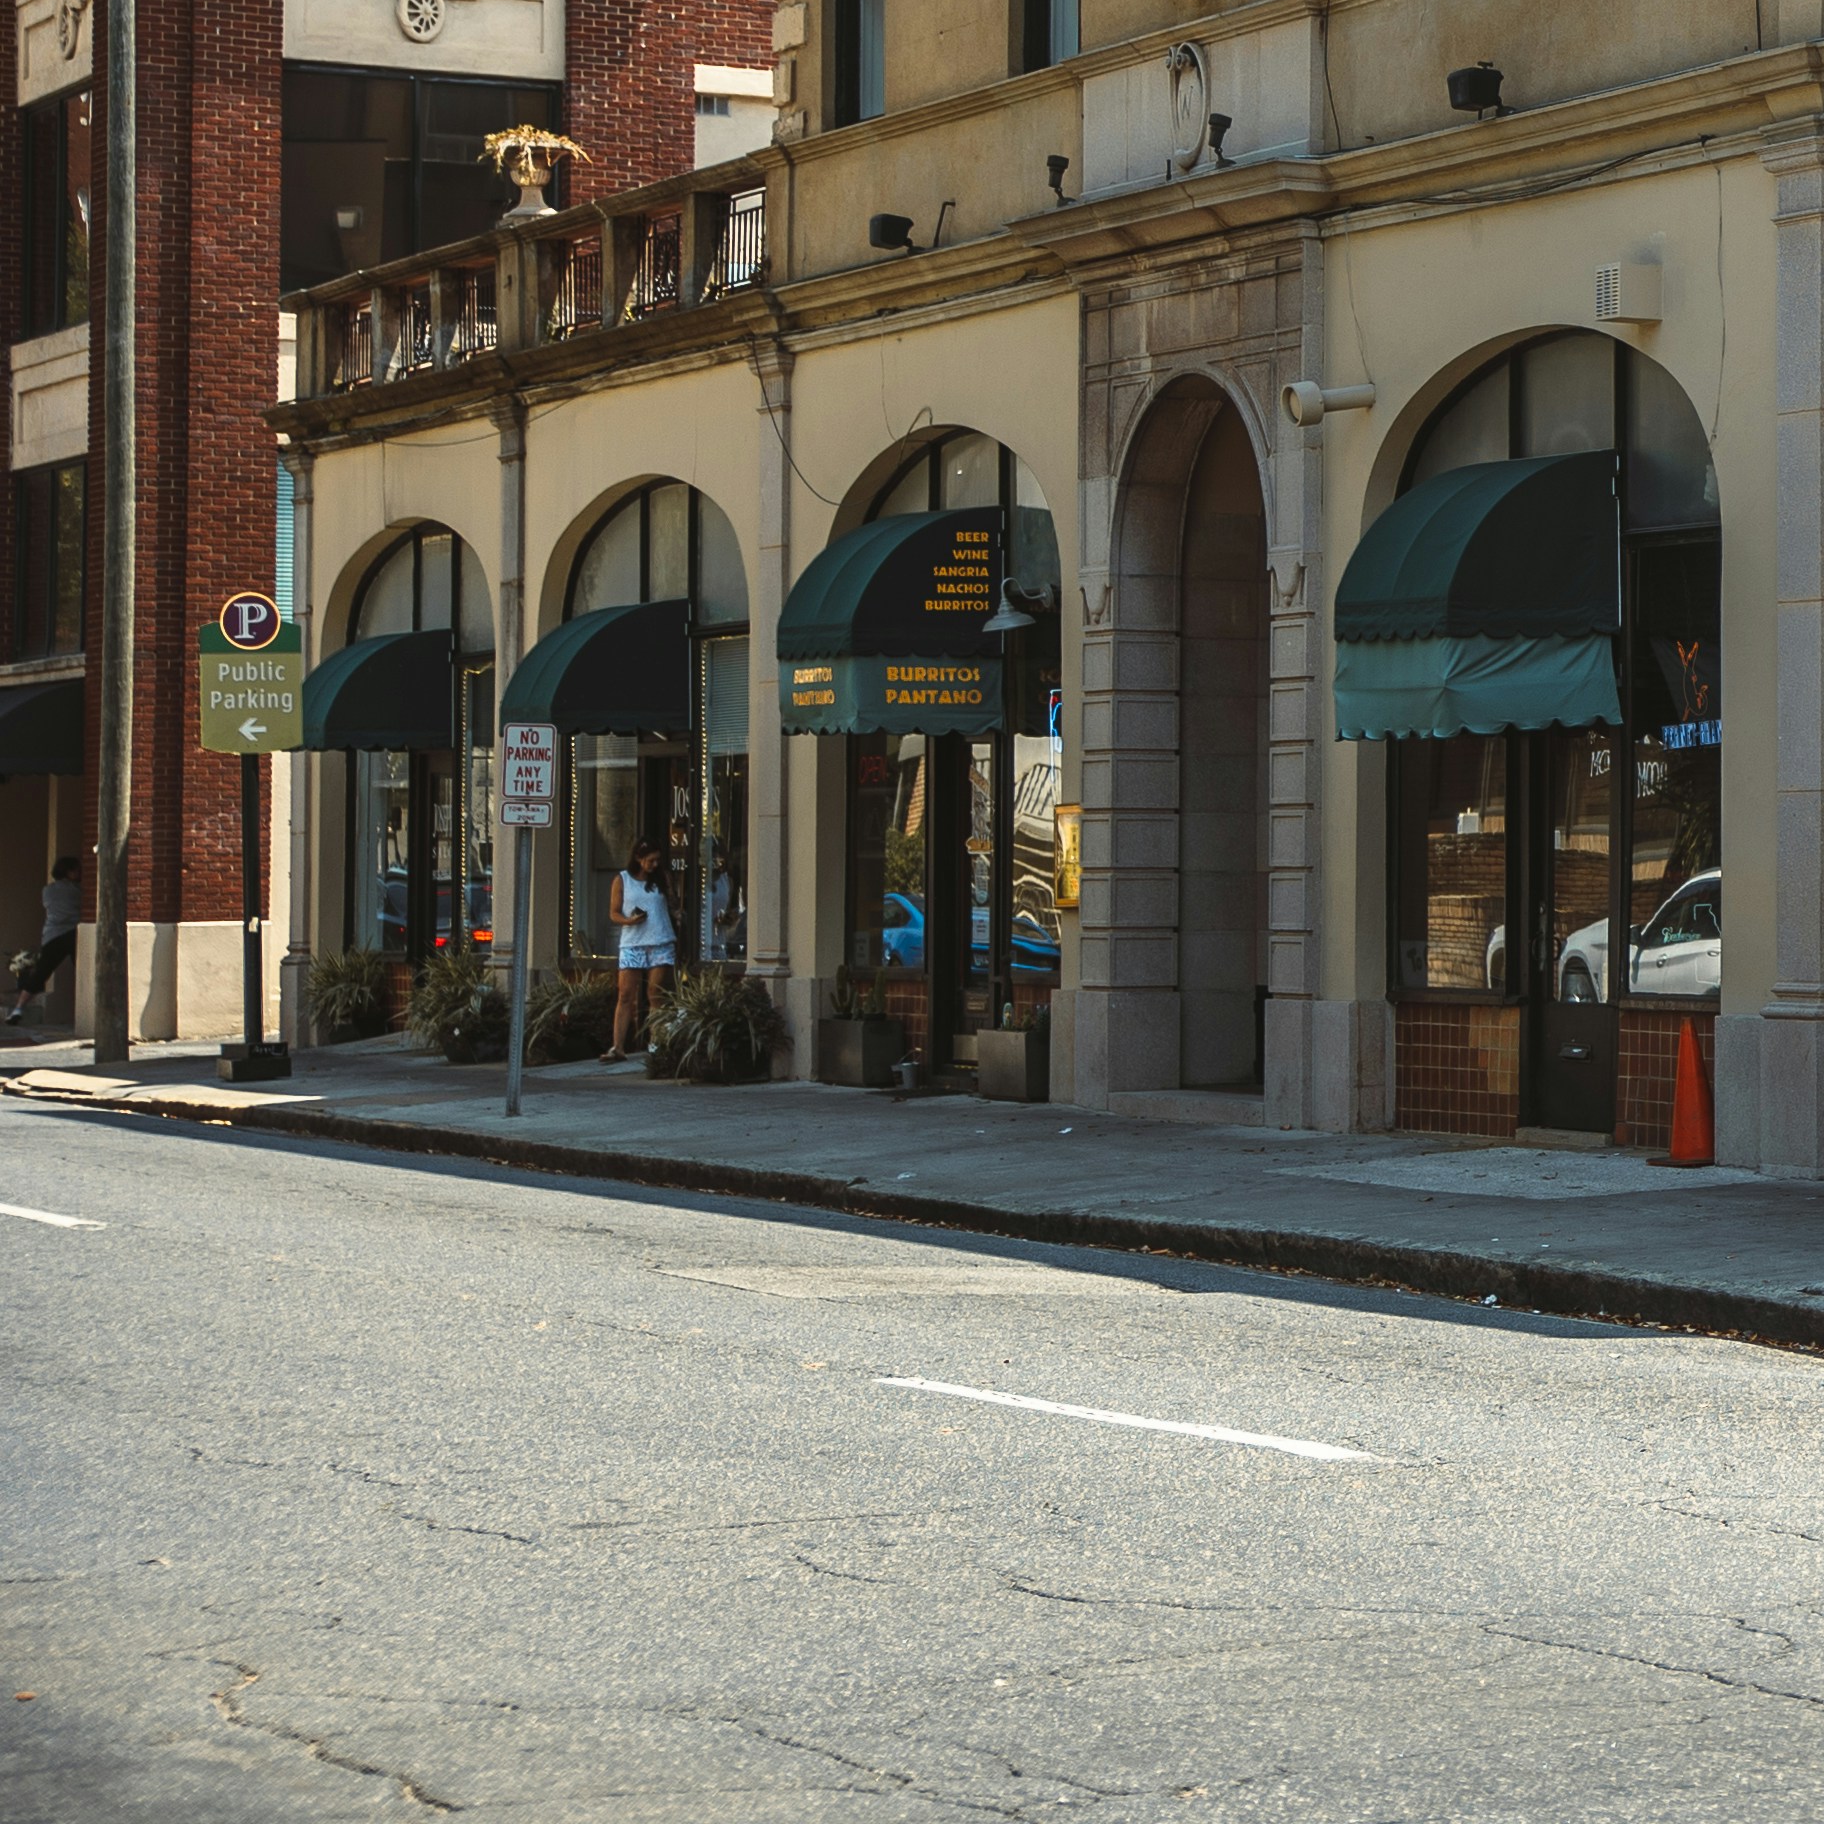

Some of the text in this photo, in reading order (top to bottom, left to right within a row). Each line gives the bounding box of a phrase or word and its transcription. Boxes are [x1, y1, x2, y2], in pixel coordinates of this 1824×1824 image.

[956, 531, 989, 543] BEER
[952, 549, 989, 560] WINE
[933, 566, 989, 577] SANGRIA
[937, 583, 989, 594] NACHOS
[925, 600, 989, 611] BURRITOS
[233, 602, 268, 639] P
[218, 661, 286, 682] Public
[793, 666, 833, 685] BURRITOS
[886, 666, 981, 682] BURRITOS
[210, 689, 293, 713] Parking
[885, 688, 983, 704] PANTANO
[520, 730, 540, 745] NO
[507, 746, 552, 762] PARKING
[516, 766, 541, 778] ANY
[513, 780, 544, 793] TIME
